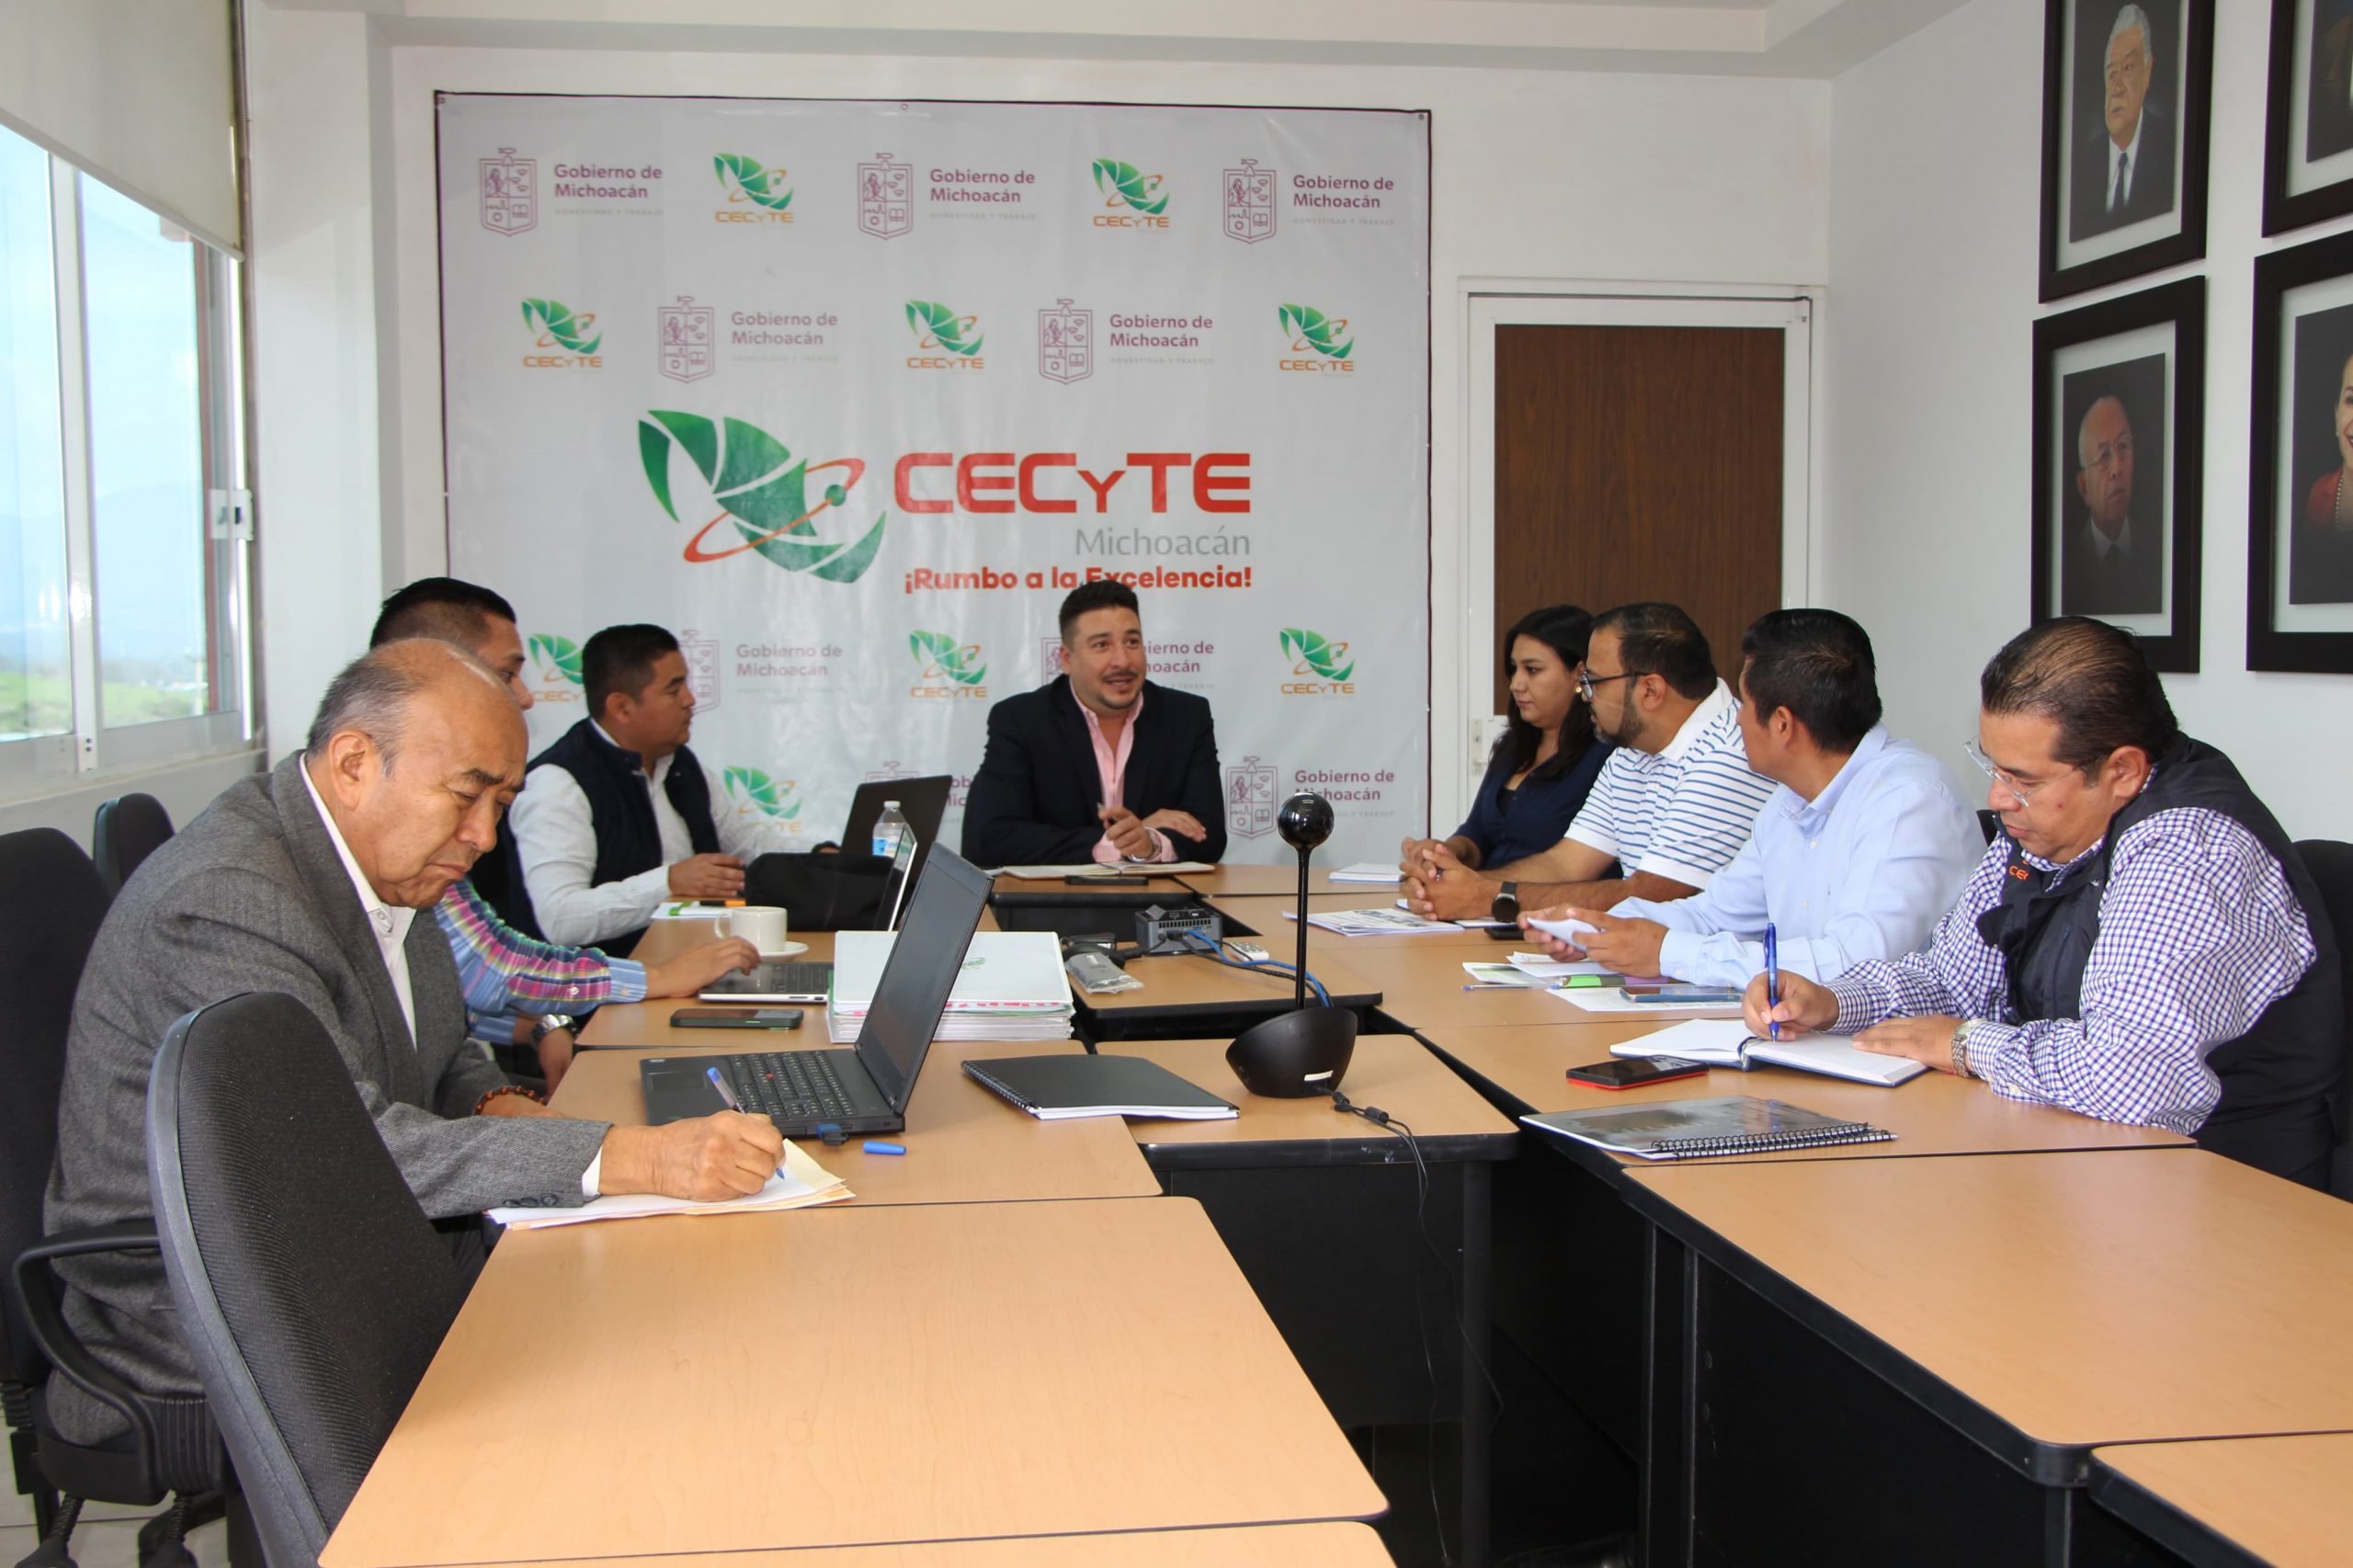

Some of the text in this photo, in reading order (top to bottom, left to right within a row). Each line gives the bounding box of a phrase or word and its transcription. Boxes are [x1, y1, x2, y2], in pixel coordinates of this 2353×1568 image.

[554, 164, 663, 179] Gobierno de
[929, 168, 1036, 184] Gobierno de
[1293, 175, 1394, 190] Gobierno de
[554, 183, 649, 199] Michoacán
[930, 187, 1021, 203] Michoacán
[1293, 192, 1381, 208] Michoacán
[731, 311, 838, 326] Gobierno de
[1109, 313, 1213, 329] Gobierno de
[732, 330, 824, 346] Michoacán
[1109, 333, 1199, 347] Michoacán
[1075, 525, 1251, 556] Michoacán
[904, 565, 1018, 595] ¡Rumbo
[1025, 570, 1044, 589] a
[1051, 565, 1077, 589] la
[736, 642, 843, 658] Gobierno de
[1194, 641, 1214, 654] de
[1294, 768, 1395, 783] Gobierno de
